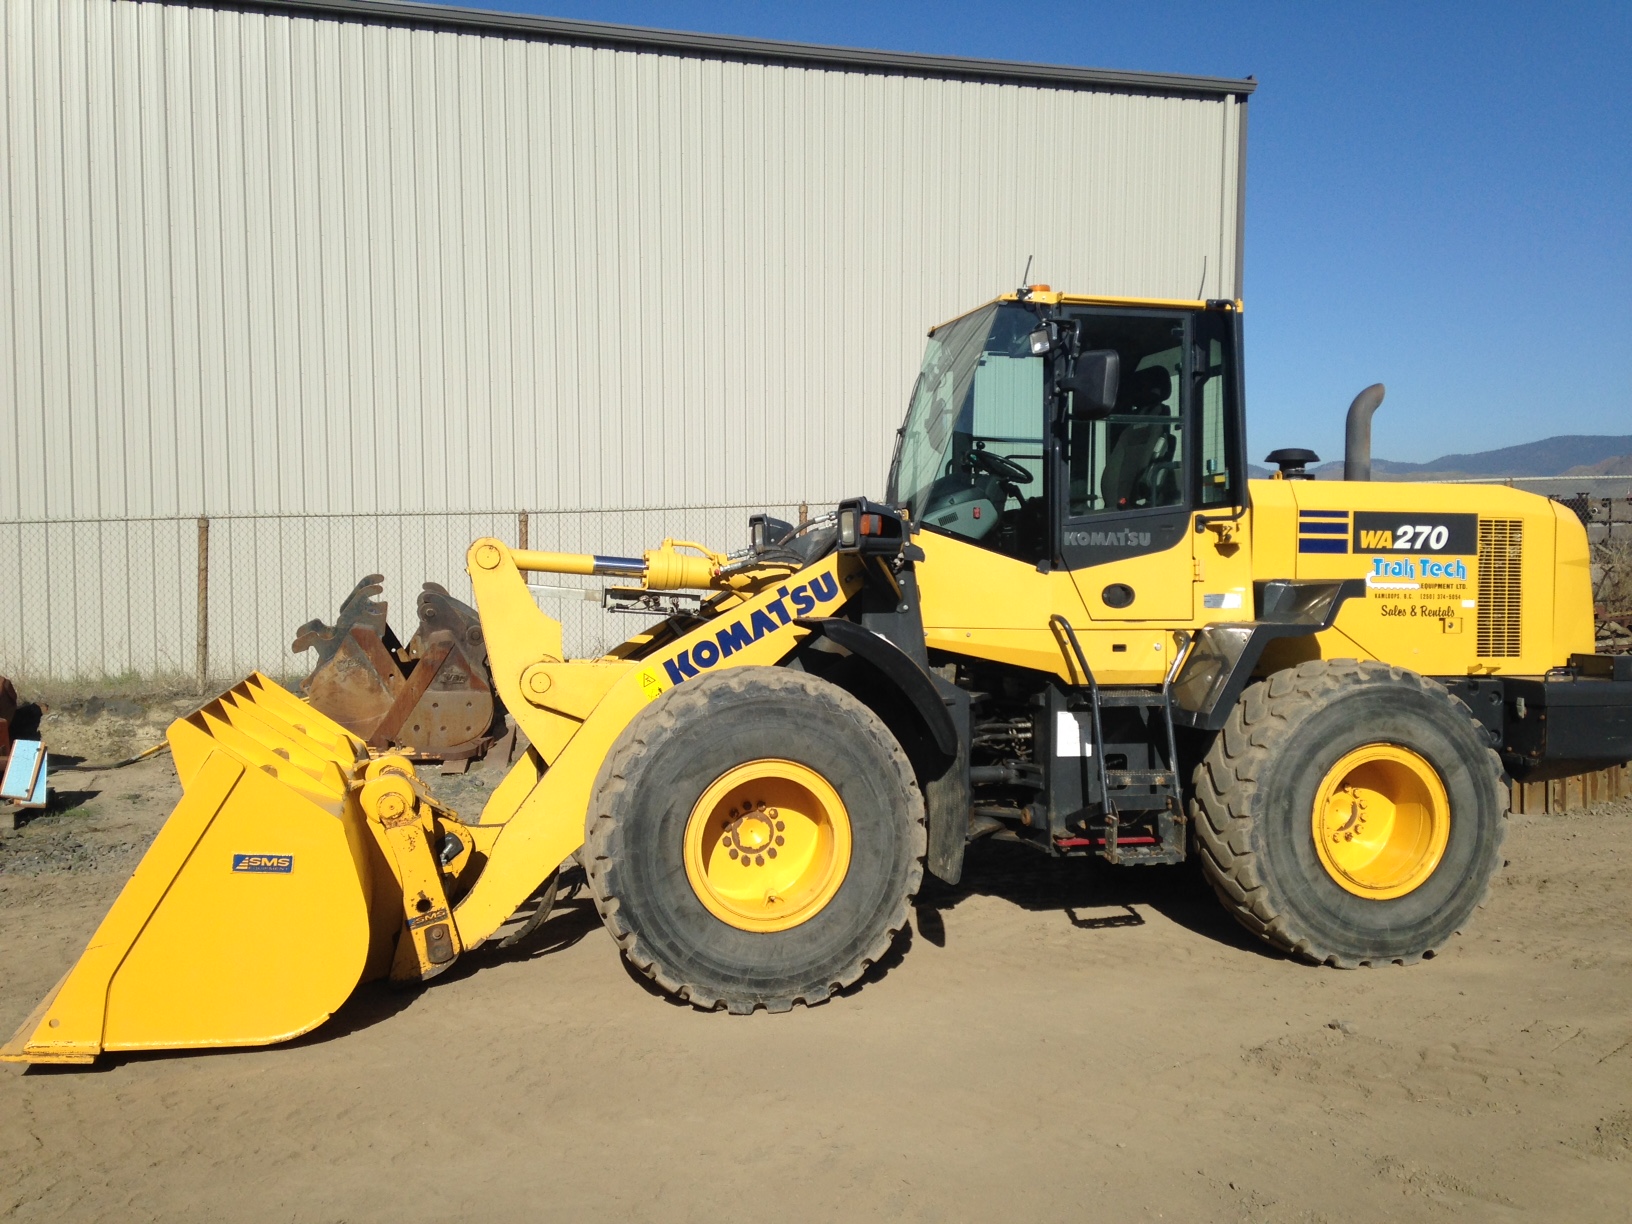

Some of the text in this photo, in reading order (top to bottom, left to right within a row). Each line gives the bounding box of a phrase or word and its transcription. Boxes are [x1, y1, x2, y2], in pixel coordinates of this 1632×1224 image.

[1063, 528, 1151, 546] KOMATSU
[1373, 558, 1467, 580] Trak Tech
[1381, 604, 1455, 617] Sales & Rentals
[662, 570, 838, 686] KOMATSU
[248, 857, 290, 867] SMS
